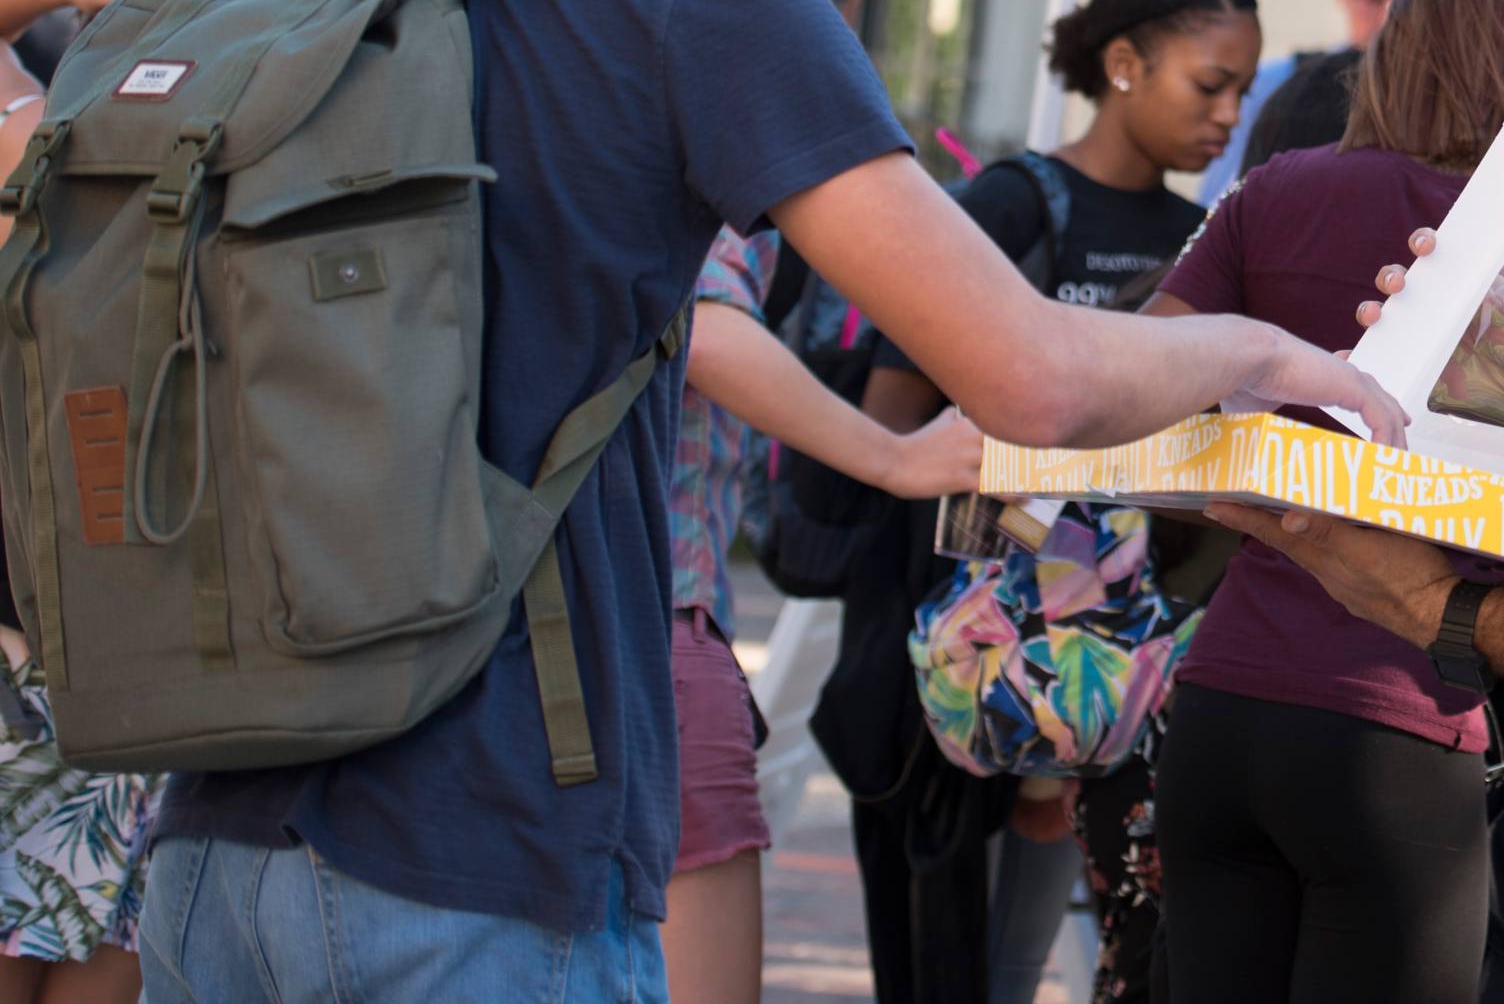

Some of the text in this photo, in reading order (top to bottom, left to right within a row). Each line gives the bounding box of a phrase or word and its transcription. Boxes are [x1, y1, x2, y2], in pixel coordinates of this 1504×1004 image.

[1156, 419, 1222, 467] KNEADS
[1262, 431, 1365, 517] DAILY
[1369, 465, 1484, 507] KNEADS
